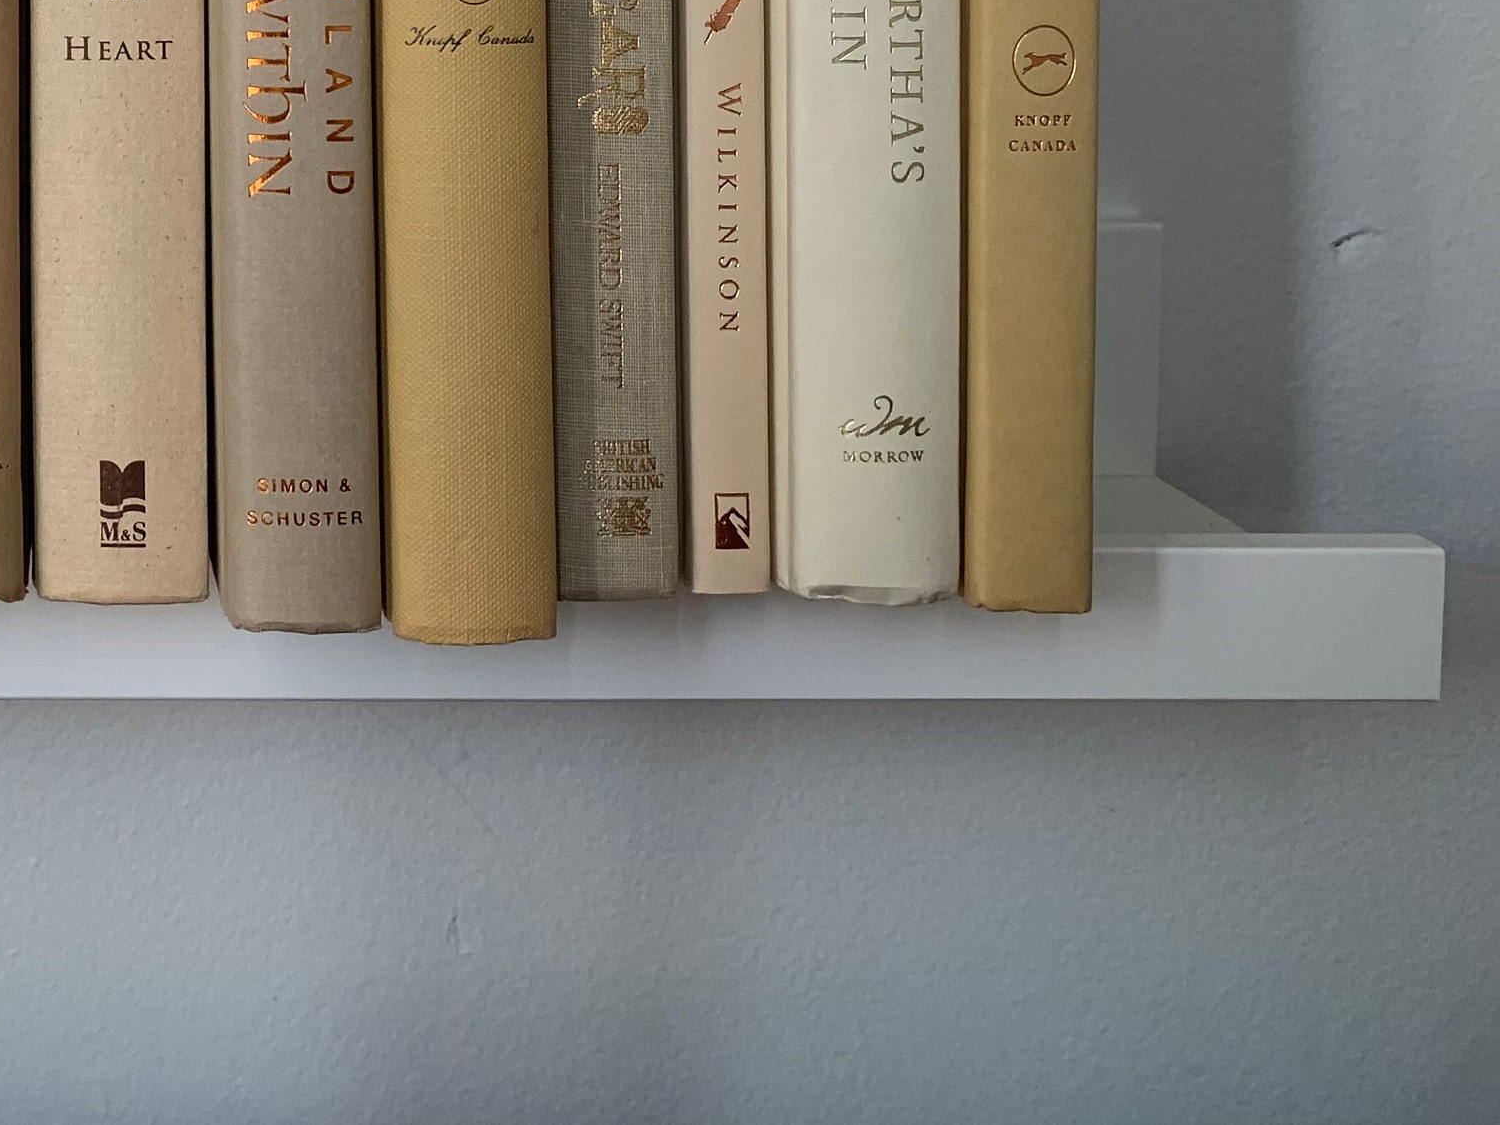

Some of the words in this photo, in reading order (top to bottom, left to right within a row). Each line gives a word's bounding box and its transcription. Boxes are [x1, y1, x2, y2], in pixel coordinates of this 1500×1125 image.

[64, 35, 174, 62] HEART
[404, 24, 473, 53] Knopf
[478, 24, 534, 46] Canada
[1014, 113, 1073, 129] KNOPF
[1008, 138, 1078, 153] CANADA
[717, 82, 743, 333] WILKINSON
[598, 162, 623, 291] EDWARD
[599, 298, 625, 389] SWIFT
[843, 450, 925, 464] MORROW
[257, 477, 329, 494] SIMON
[339, 477, 351, 493] &
[247, 509, 363, 527] SCHUSTER
[100, 521, 147, 542] M&S
